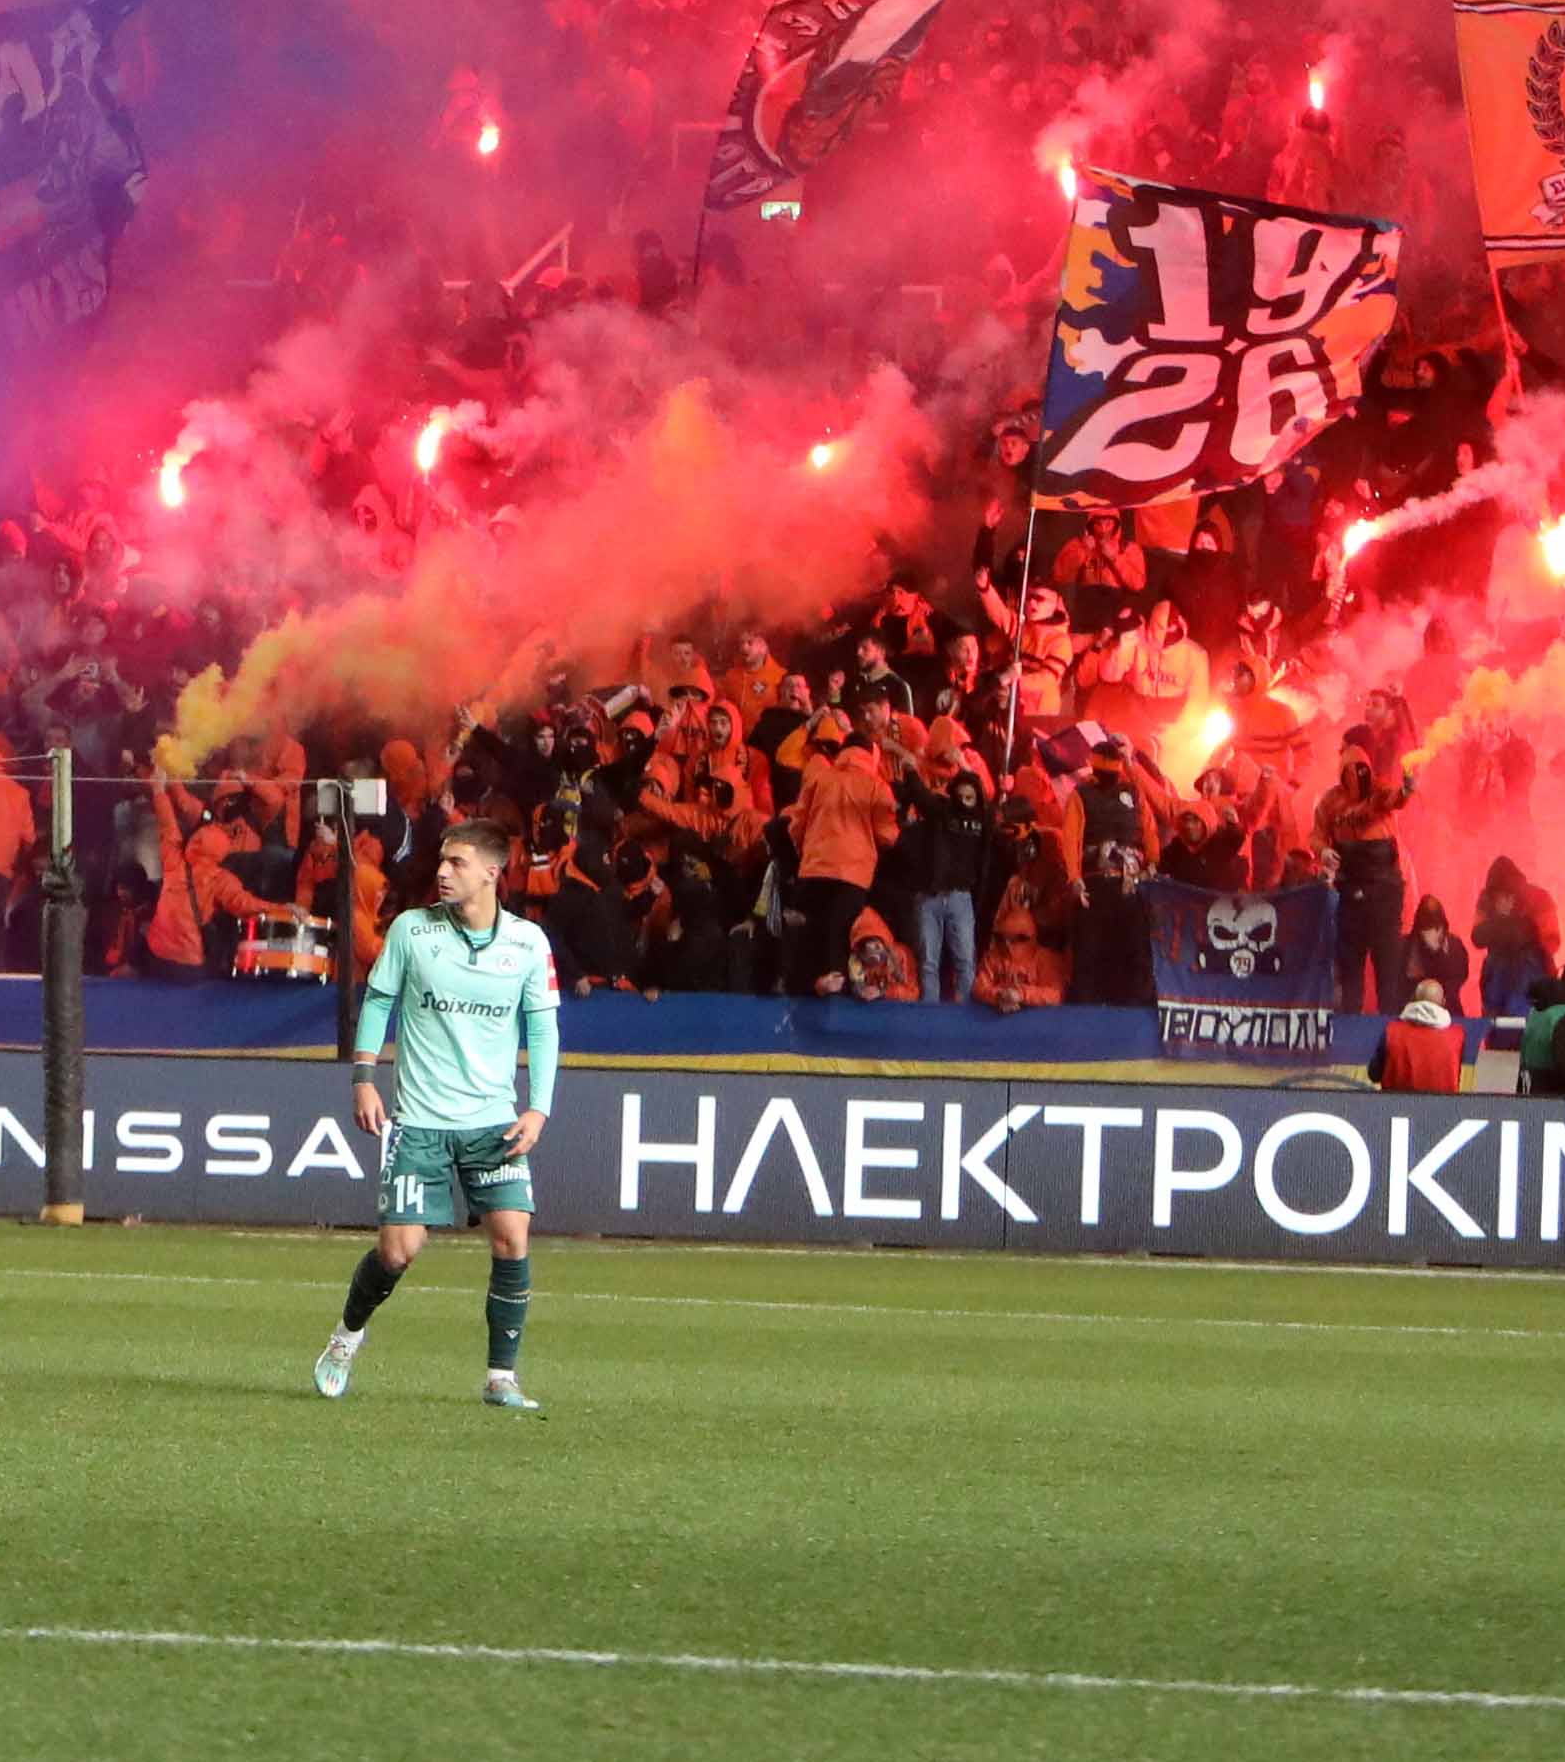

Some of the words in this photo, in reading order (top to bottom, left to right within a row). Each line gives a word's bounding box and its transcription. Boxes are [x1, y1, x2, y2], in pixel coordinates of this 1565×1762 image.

[1128, 202, 1345, 342] 19
[1044, 338, 1338, 482] 26
[393, 1174, 424, 1214] 14
